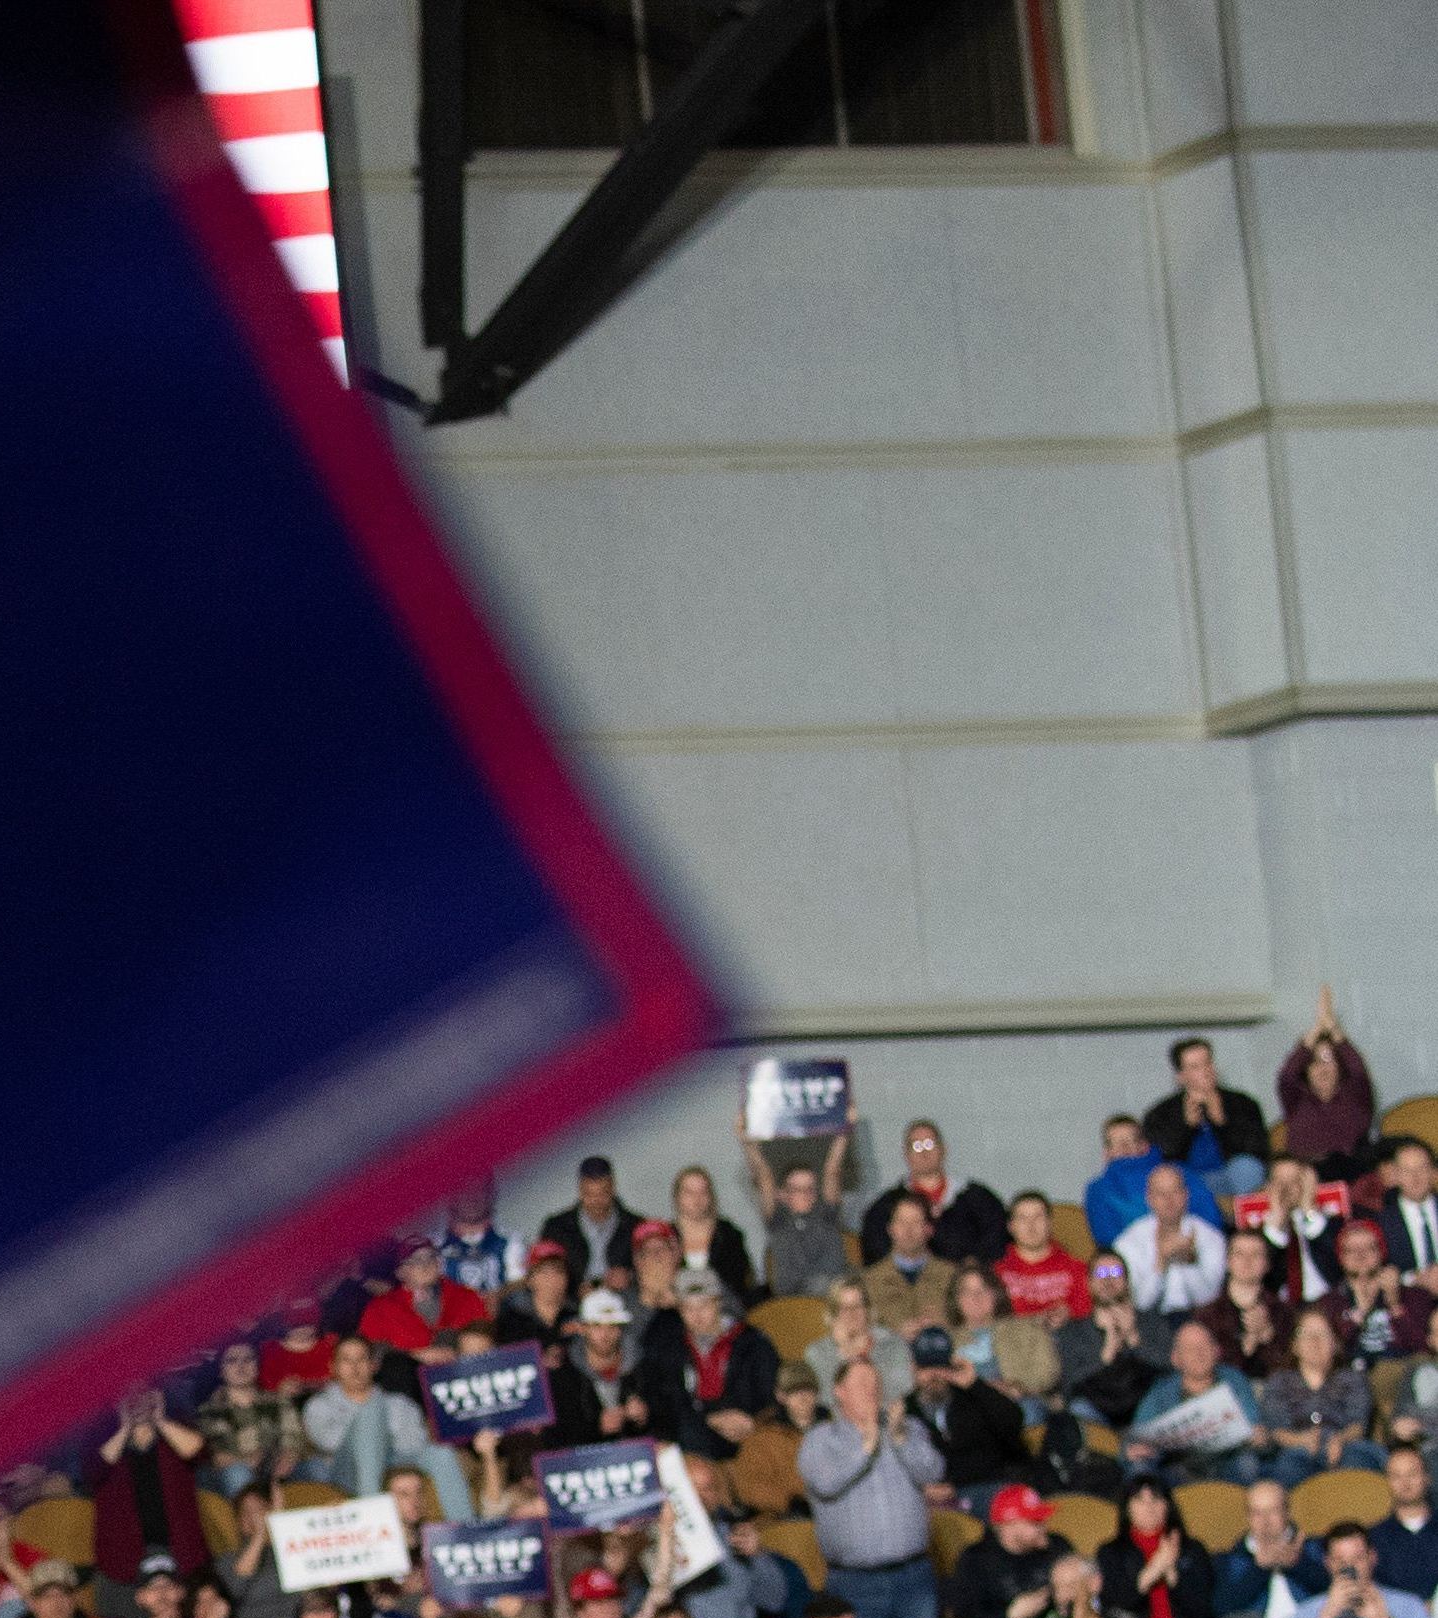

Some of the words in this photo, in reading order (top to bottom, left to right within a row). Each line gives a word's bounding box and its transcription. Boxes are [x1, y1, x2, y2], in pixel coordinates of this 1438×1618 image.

[431, 1363, 537, 1399] TRUMP
[545, 1459, 653, 1490] TRUMP
[286, 1528, 393, 1553] AMERICA
[433, 1536, 542, 1565] TRUMP
